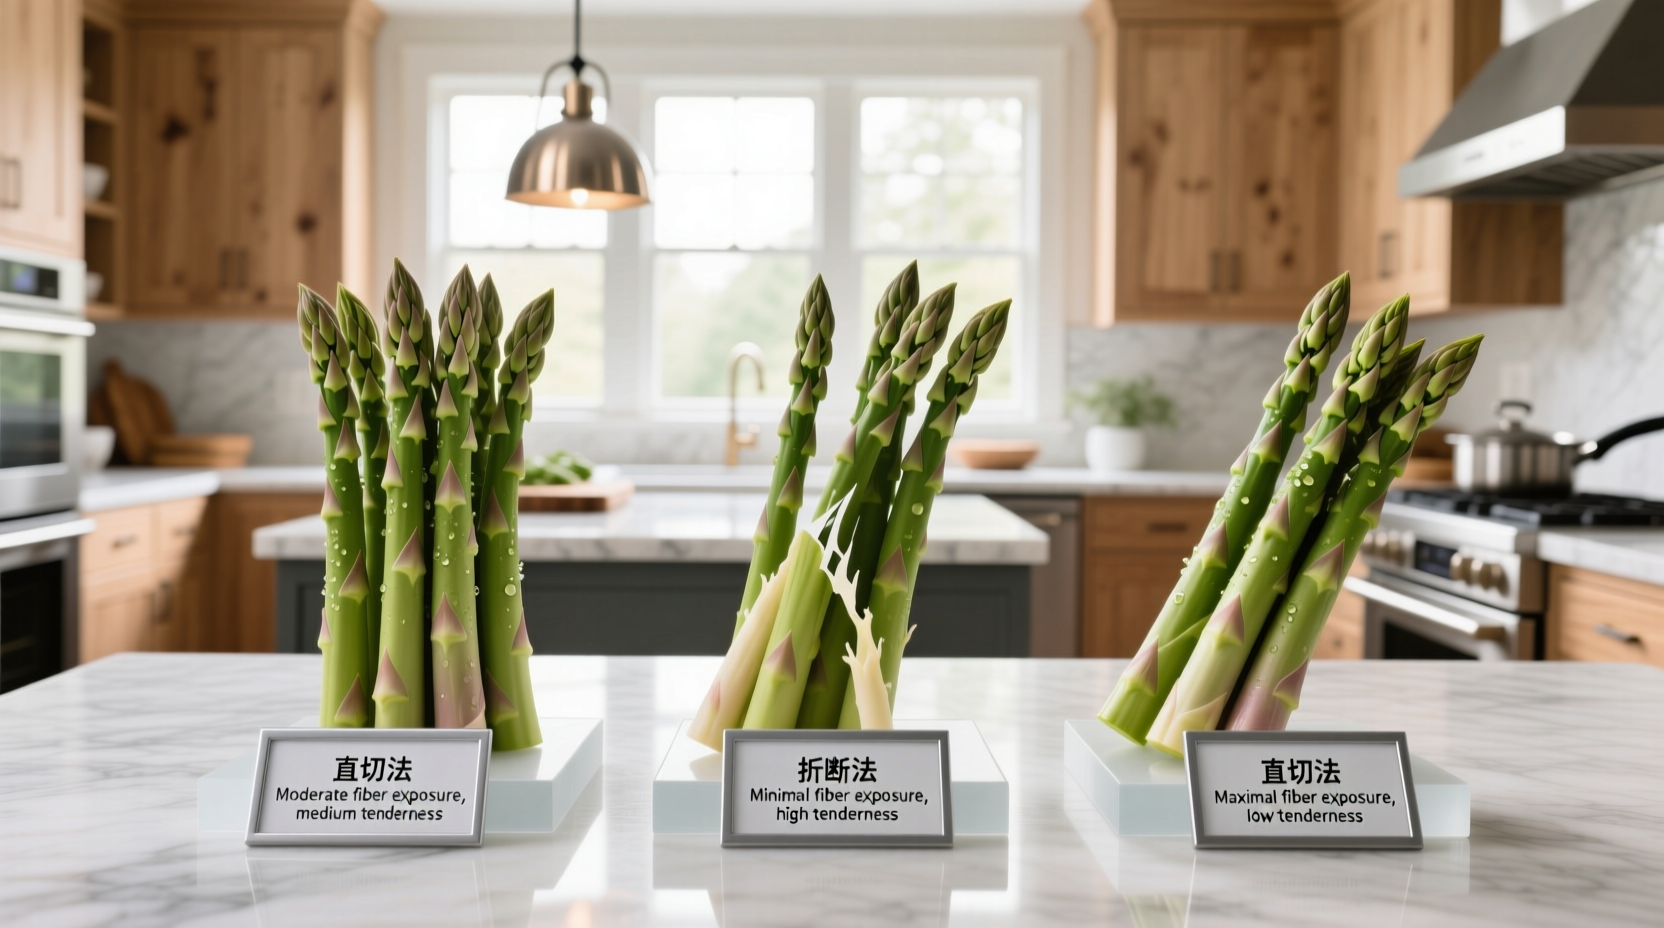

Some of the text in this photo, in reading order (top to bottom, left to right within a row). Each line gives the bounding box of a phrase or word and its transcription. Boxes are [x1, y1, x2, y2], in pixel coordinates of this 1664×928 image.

[333, 755, 412, 782] 直切法
[1261, 758, 1341, 784] 直切法
[276, 787, 466, 805] Moderate fiber exposure,
[750, 787, 929, 805] Minimal fiber exposure,
[1214, 789, 1396, 807] Maximal fiber exposure,
[296, 806, 443, 820] medium tenderness
[777, 807, 899, 824] high tenderness
[1247, 809, 1363, 822] low tenderness
